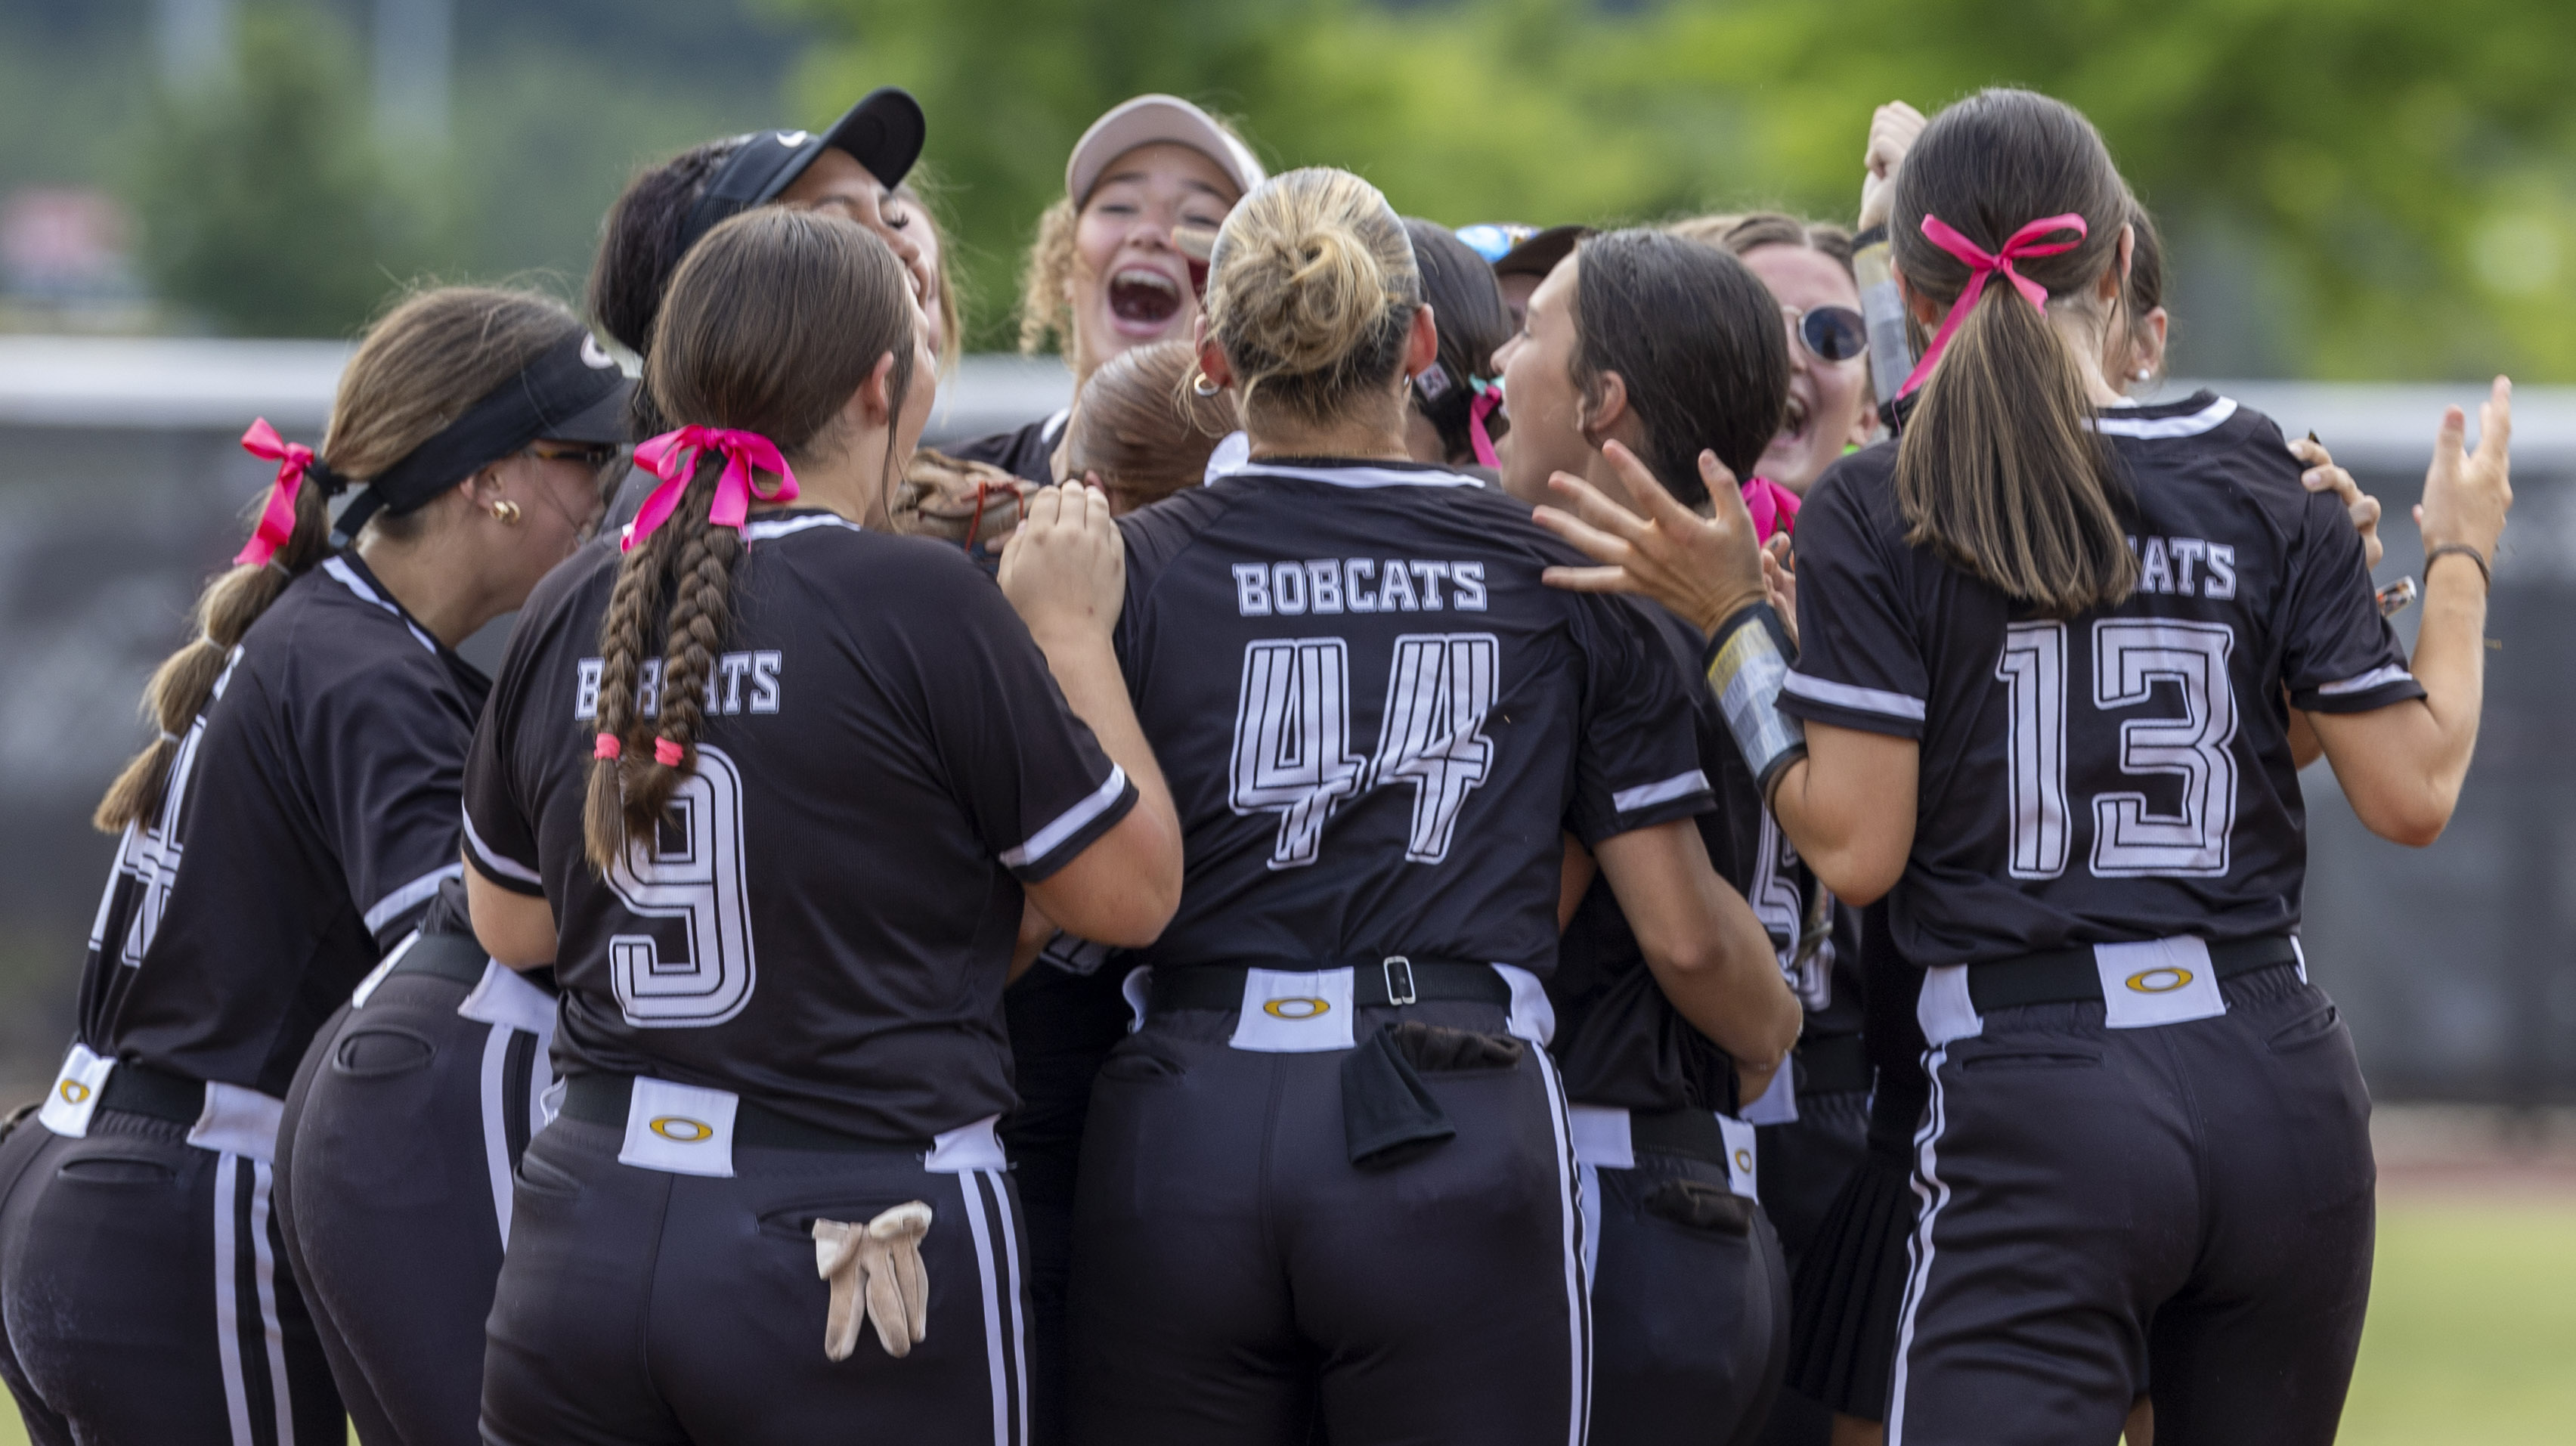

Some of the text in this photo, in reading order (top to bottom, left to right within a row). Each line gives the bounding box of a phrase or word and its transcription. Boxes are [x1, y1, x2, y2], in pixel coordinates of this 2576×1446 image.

[1232, 558, 1488, 617] BOBCATS
[1229, 632, 1500, 871] 44
[1995, 618, 2238, 881] 13
[603, 742, 756, 1028] 9
